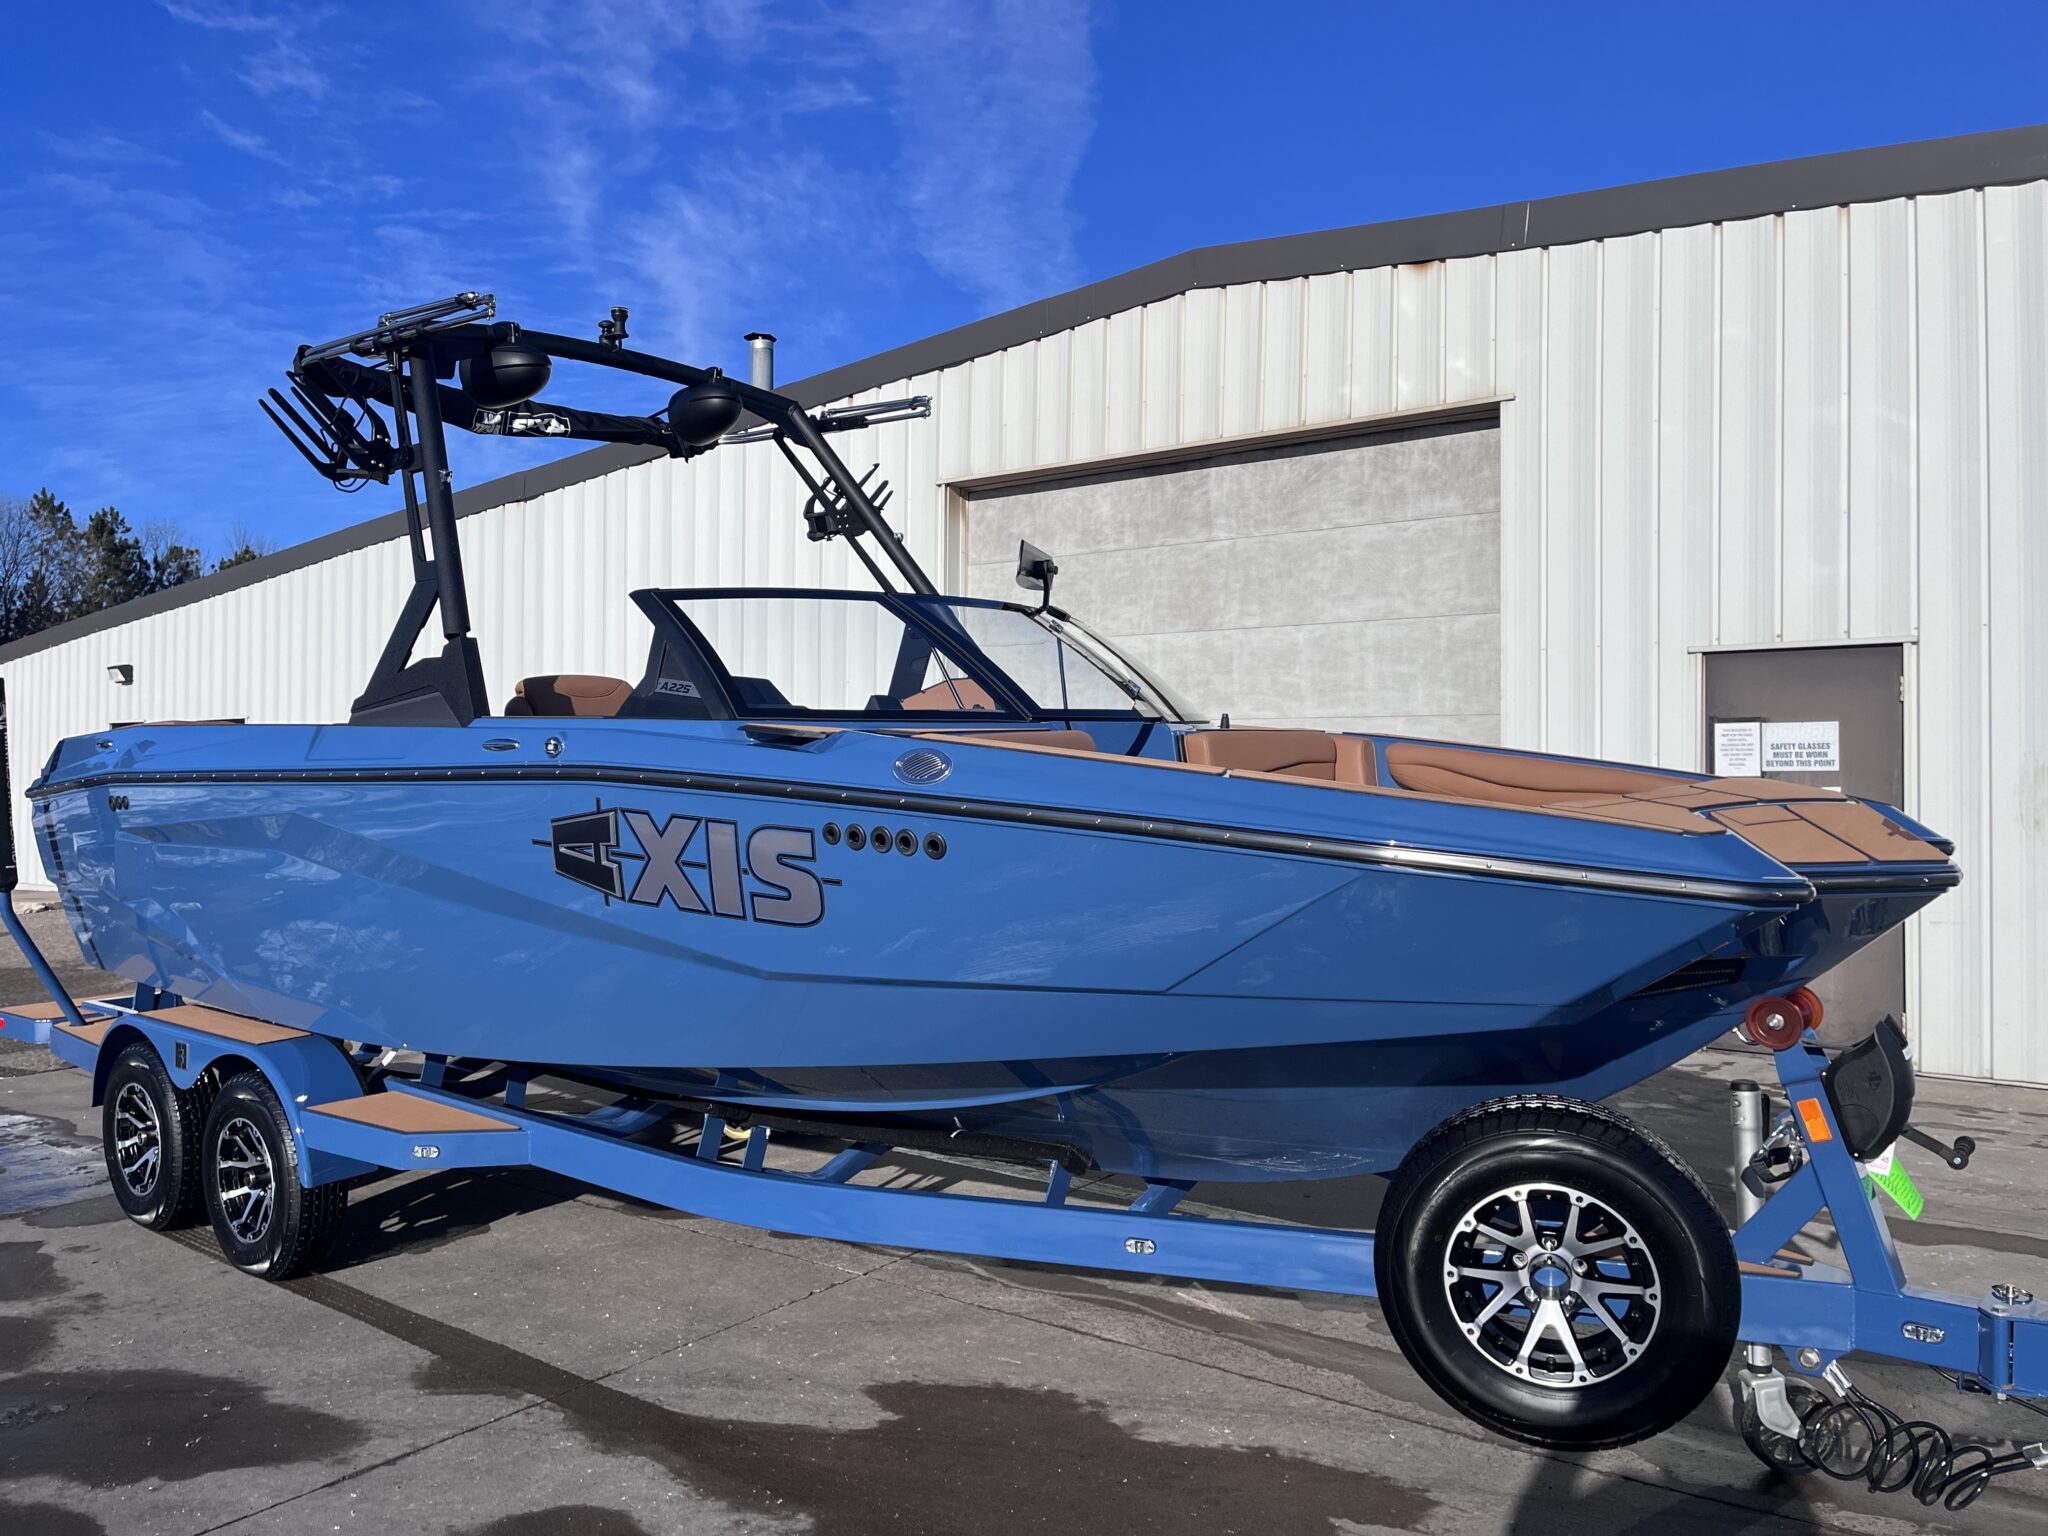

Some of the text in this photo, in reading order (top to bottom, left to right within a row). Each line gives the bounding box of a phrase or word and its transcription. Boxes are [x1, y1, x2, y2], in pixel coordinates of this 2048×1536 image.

[660, 681, 692, 694] A225
[1770, 742, 1831, 750] SAFETY GLASSES
[1773, 751, 1793, 759] MUST
[551, 806, 826, 928] AXIS
